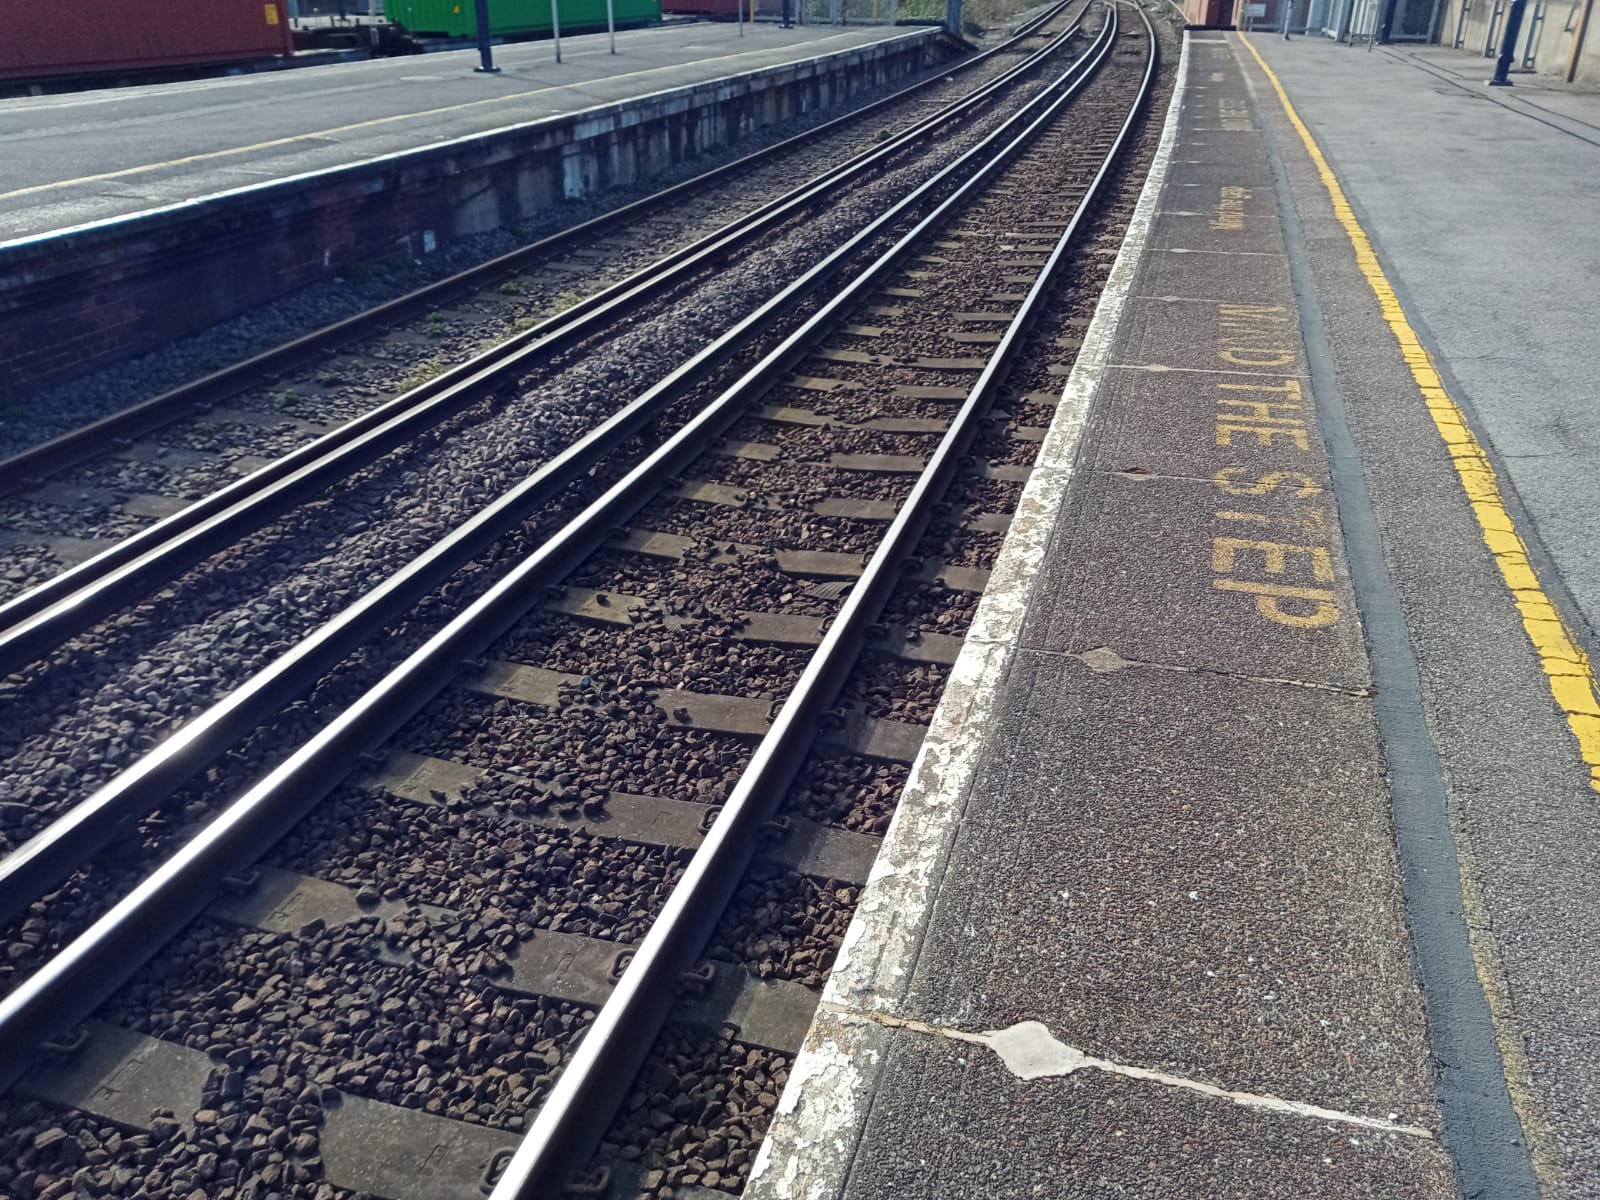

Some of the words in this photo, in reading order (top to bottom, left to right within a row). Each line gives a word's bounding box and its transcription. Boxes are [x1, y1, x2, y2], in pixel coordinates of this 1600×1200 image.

[1218, 303, 1295, 366] MIND
[1215, 380, 1309, 450] THE
[1211, 466, 1340, 629] STEP
